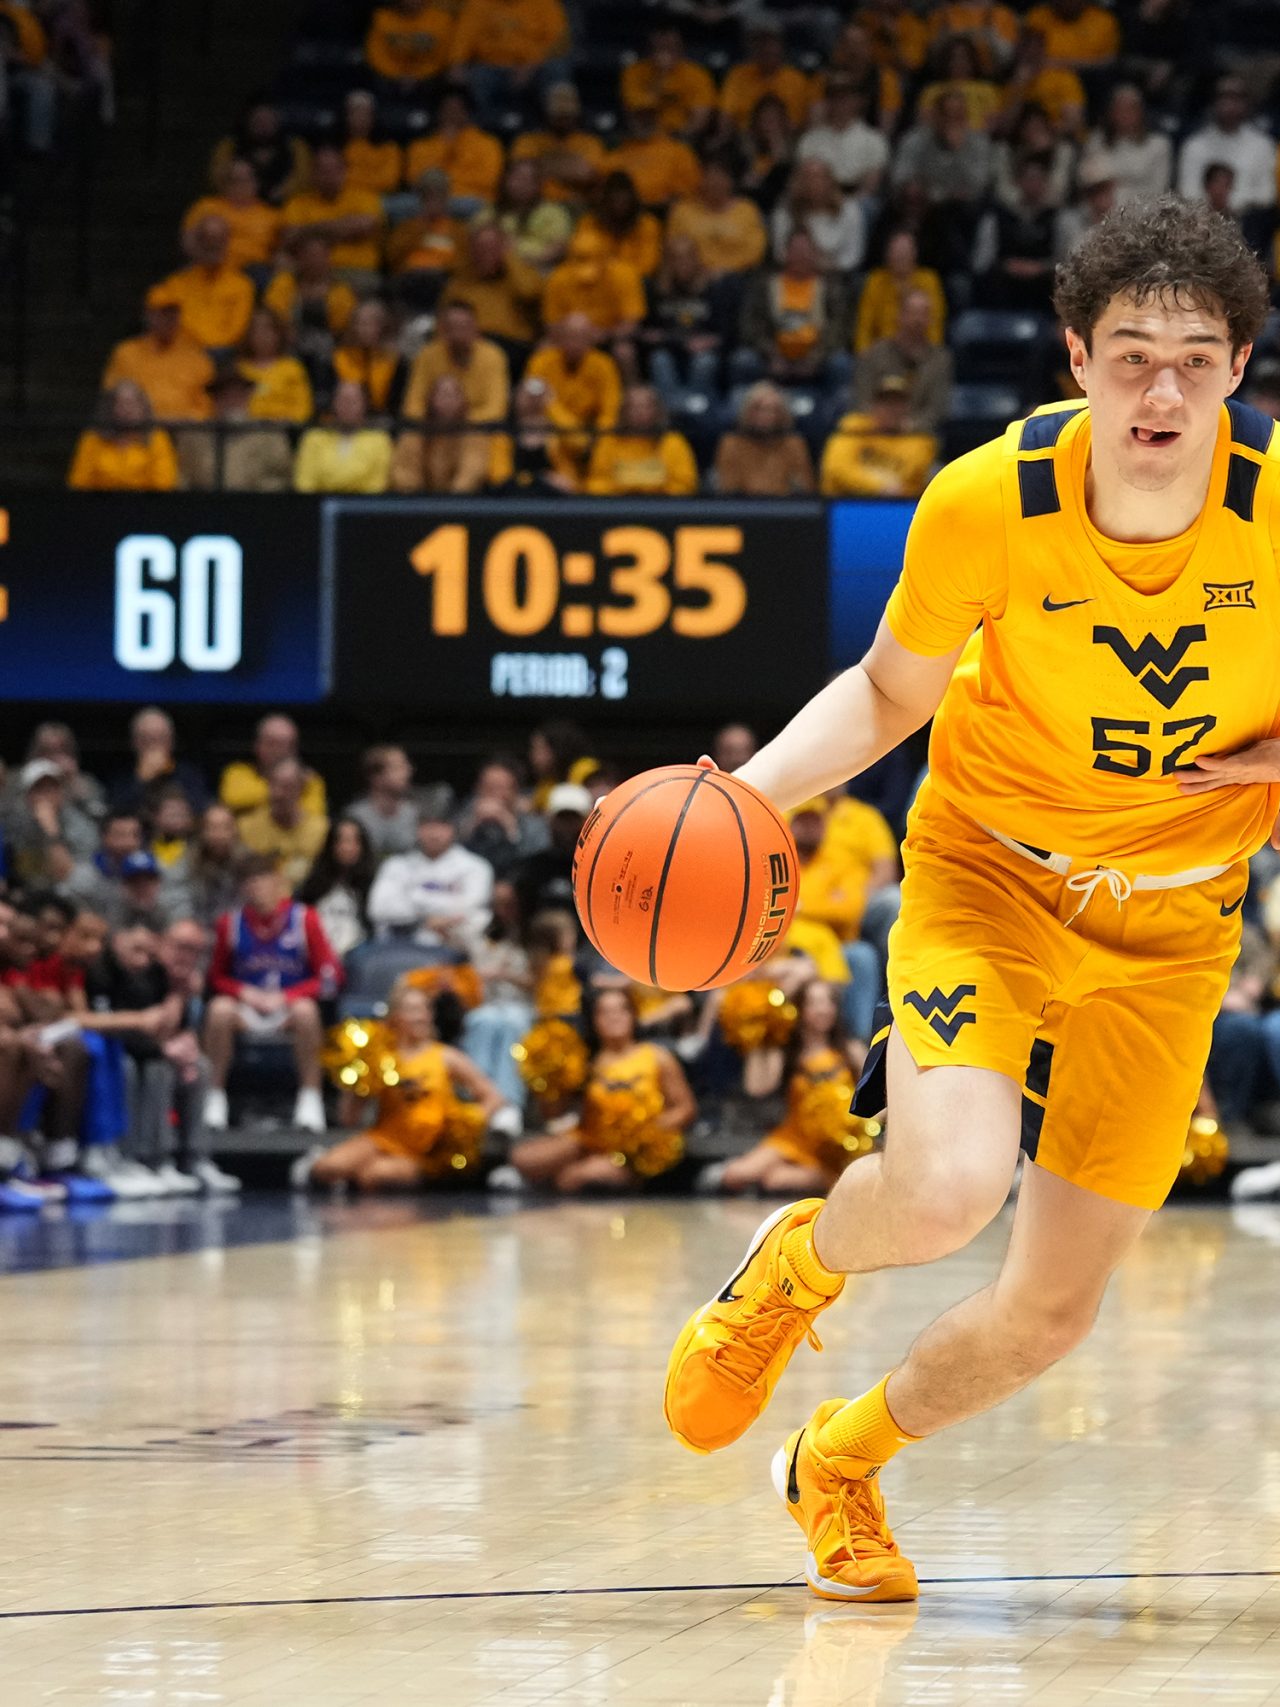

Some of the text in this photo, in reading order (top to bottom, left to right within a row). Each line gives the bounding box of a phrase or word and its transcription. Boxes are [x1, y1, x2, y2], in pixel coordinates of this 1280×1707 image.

[114, 533, 243, 672] 60
[409, 523, 747, 638] 10:35
[600, 646, 628, 700] 2
[1091, 714, 1217, 777] 52
